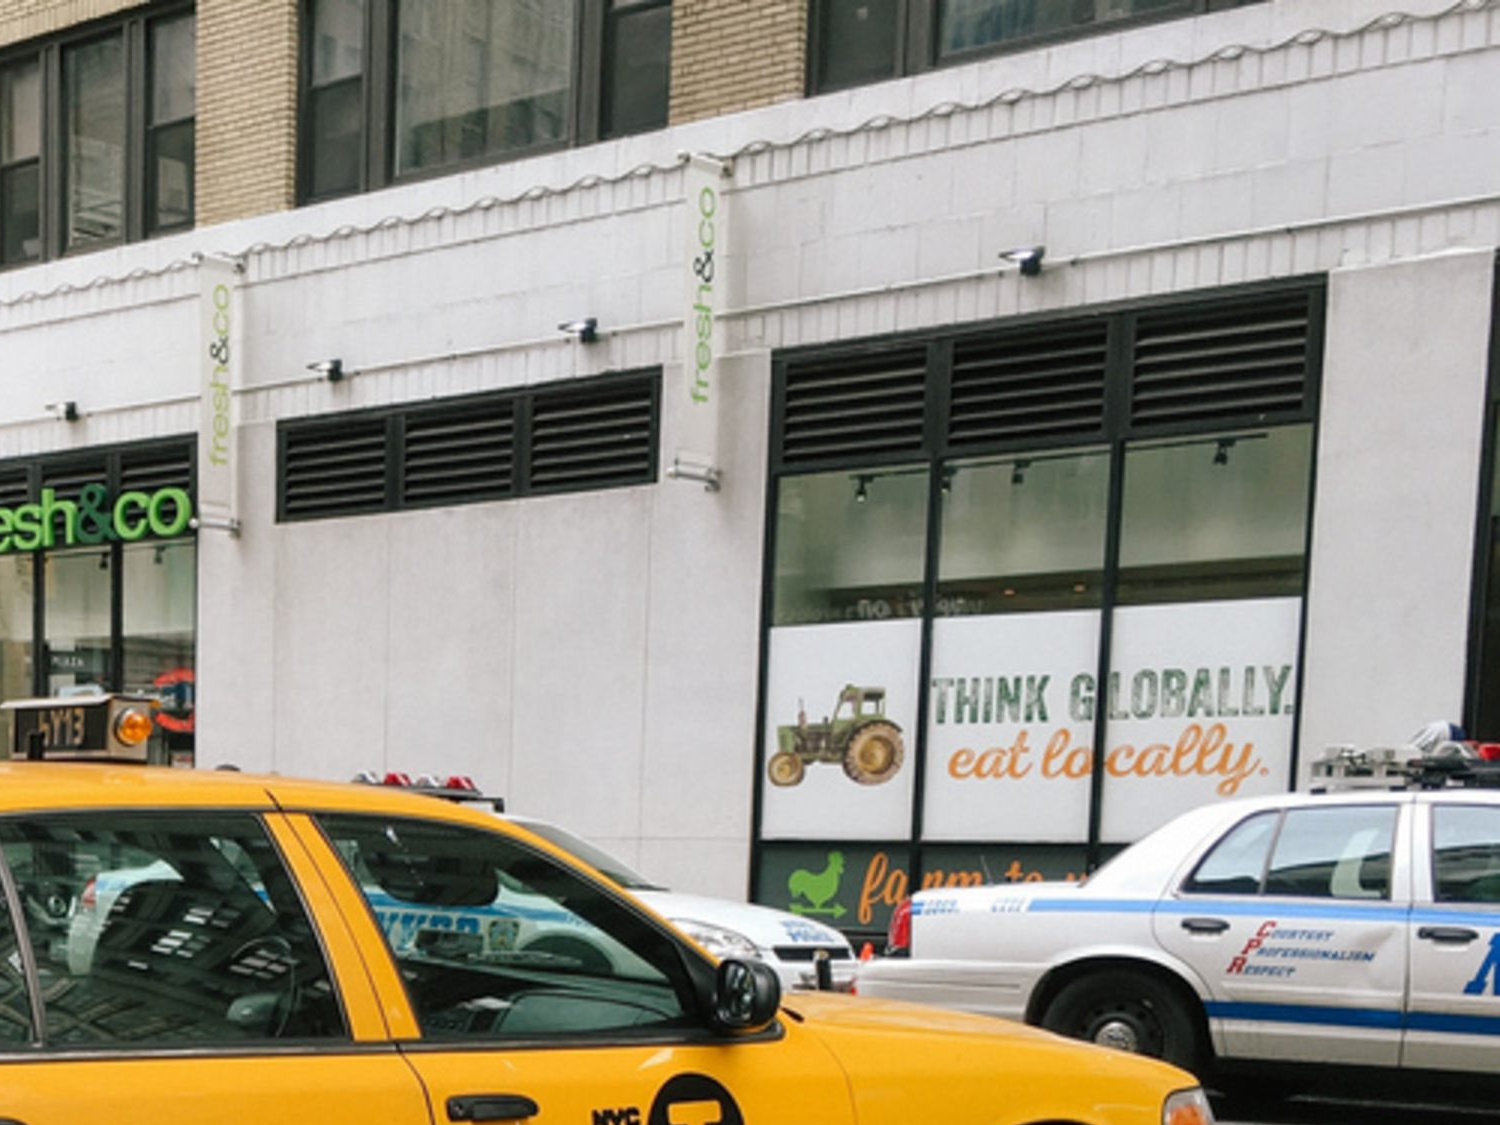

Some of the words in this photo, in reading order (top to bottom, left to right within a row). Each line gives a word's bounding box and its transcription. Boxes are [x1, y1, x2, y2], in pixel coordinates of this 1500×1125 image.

[690, 187, 717, 402] fresh&co
[209, 284, 230, 466] fresh&co
[932, 674, 1051, 724] THINK
[948, 729, 1033, 779] eat
[1040, 723, 1270, 796] locally.
